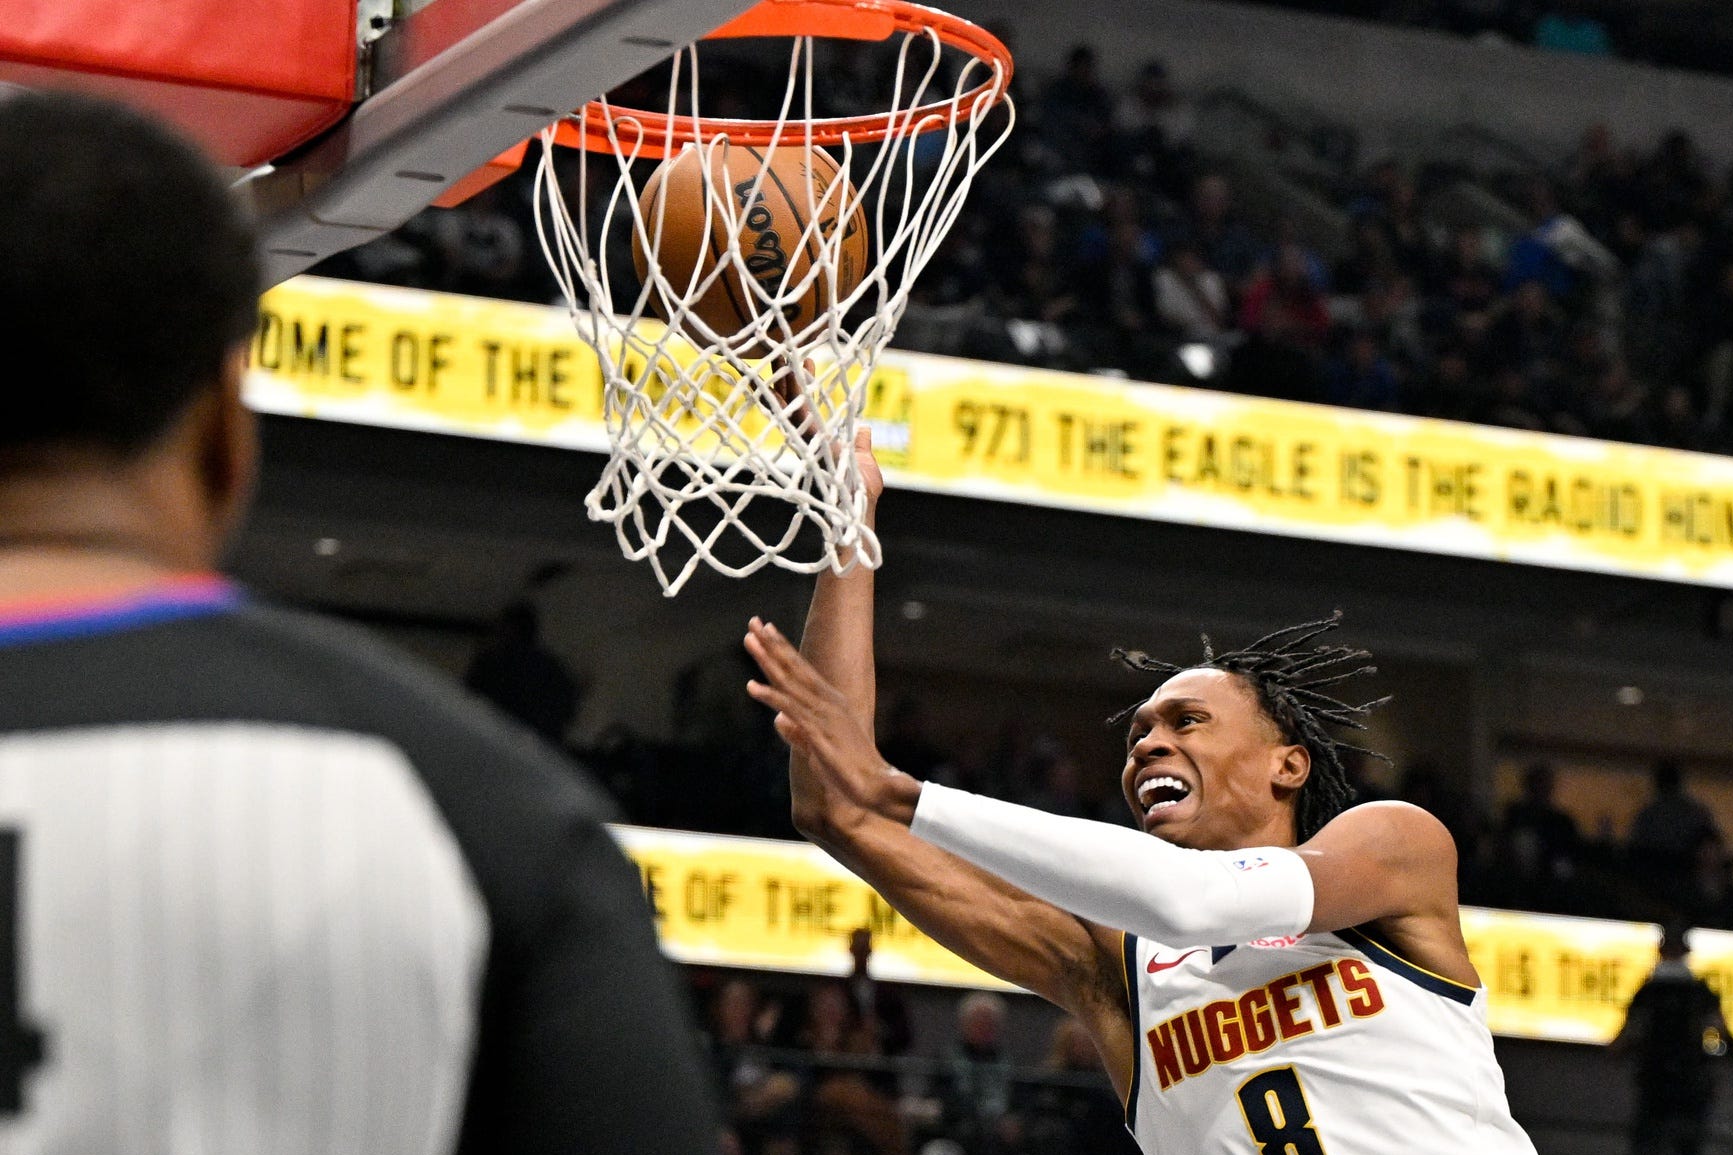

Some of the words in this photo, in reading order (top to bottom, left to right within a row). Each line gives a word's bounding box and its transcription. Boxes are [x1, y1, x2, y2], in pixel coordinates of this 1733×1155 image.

[734, 174, 802, 331] lson
[257, 309, 363, 383] OME
[390, 330, 452, 392] OF
[481, 340, 572, 411] THE
[953, 400, 1031, 463] 971
[1057, 412, 1139, 481] THE
[1162, 425, 1315, 502] EAGLE
[1339, 450, 1382, 509] IS
[1404, 455, 1483, 522] THE
[1507, 469, 1643, 539] RADIO
[685, 873, 738, 922] OF
[766, 878, 844, 936] THE
[1146, 958, 1386, 1092] NUGGETS
[1503, 949, 1536, 1000] IS
[1556, 952, 1622, 1010] THE
